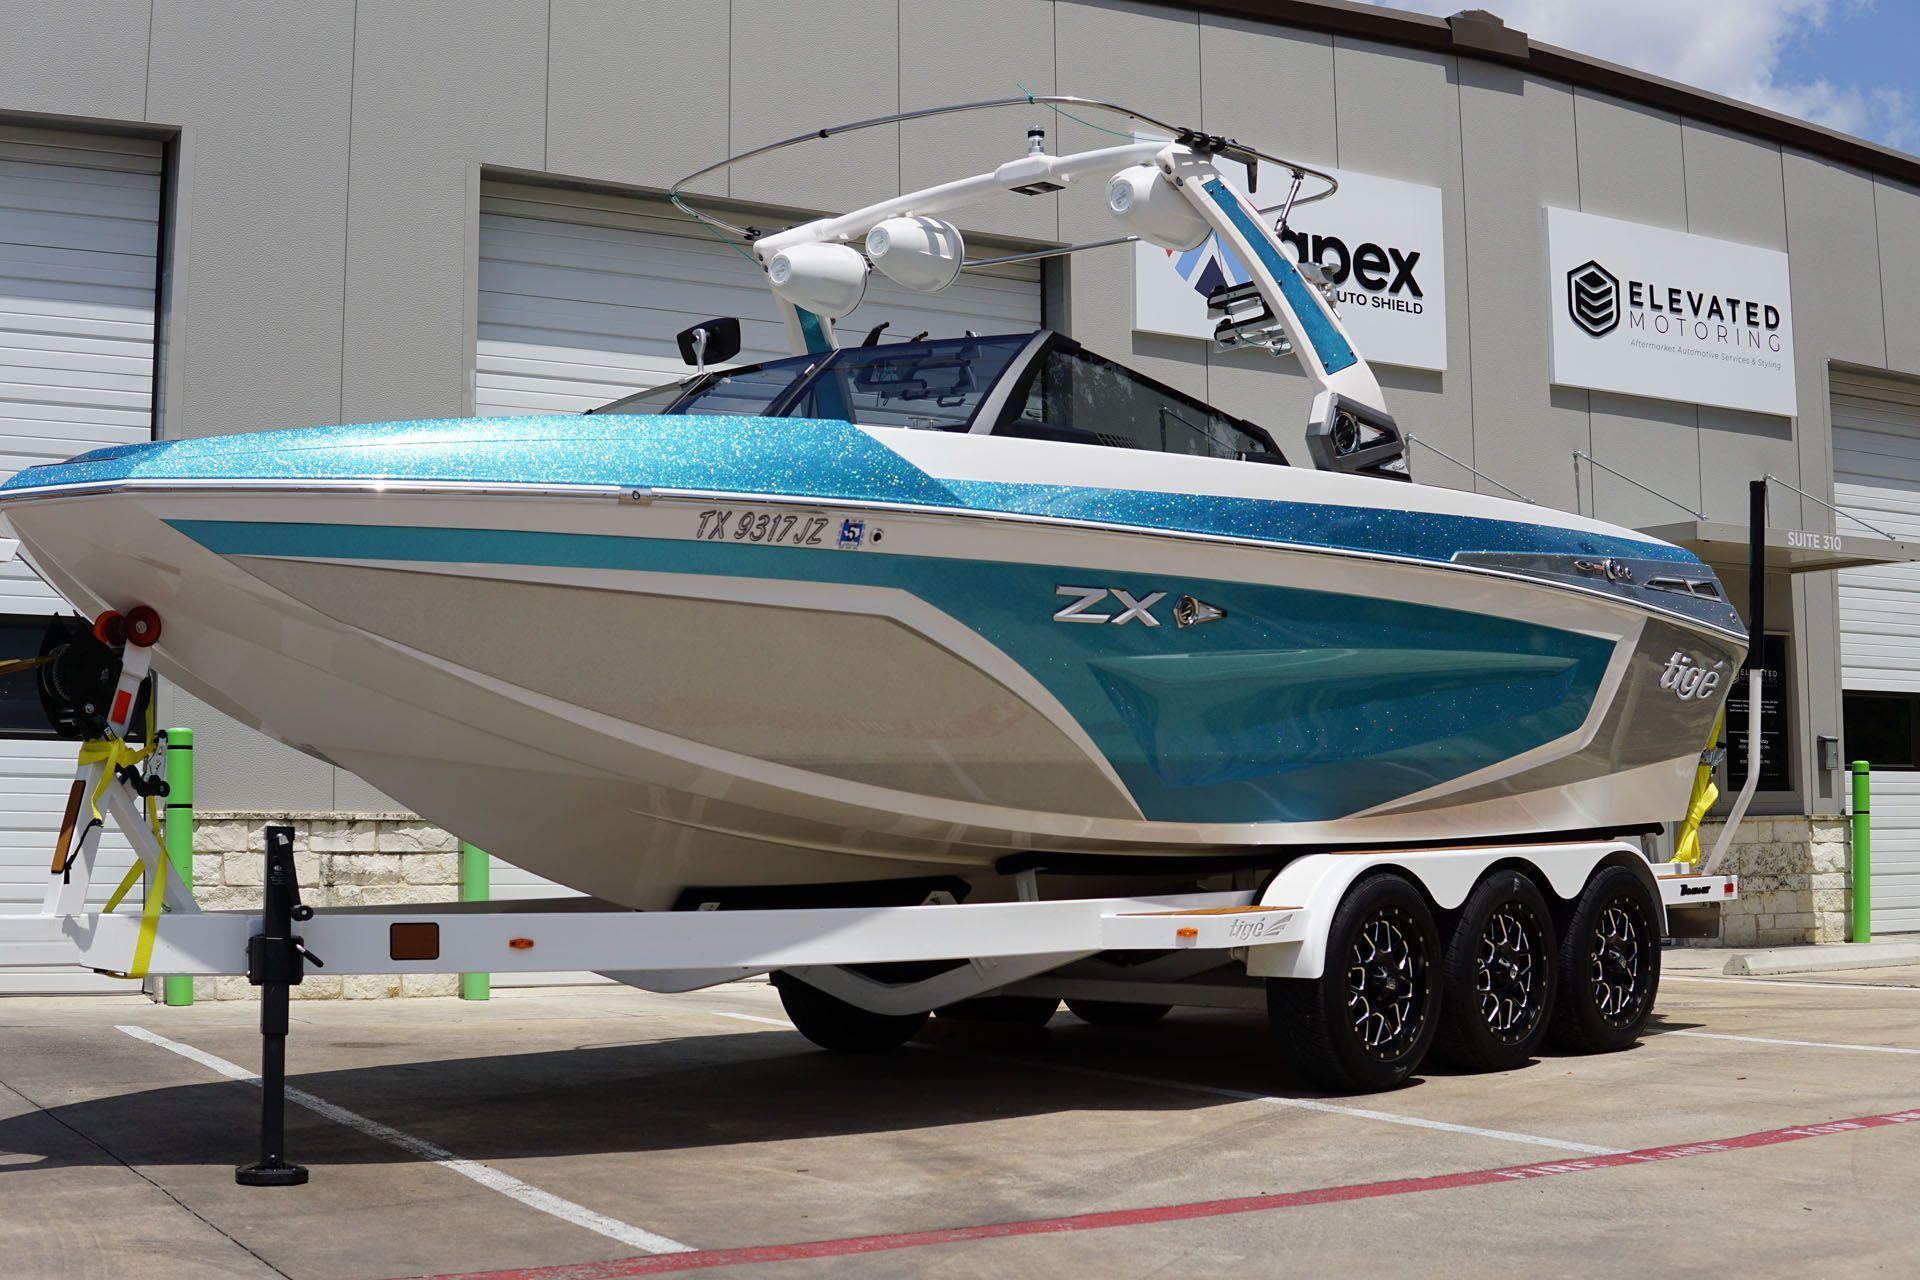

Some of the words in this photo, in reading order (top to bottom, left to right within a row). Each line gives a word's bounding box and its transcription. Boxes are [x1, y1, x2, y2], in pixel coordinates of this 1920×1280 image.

[1336, 291, 1367, 305] UTO
[1371, 296, 1423, 315] SHIELD
[1628, 280, 1780, 329] ELEVATED
[1629, 310, 1780, 352] MOTORING
[1630, 339, 1675, 353] Aftermarket
[1677, 346, 1719, 360] Automotive
[1721, 353, 1750, 365] Services
[1757, 358, 1781, 371] Styling
[696, 510, 732, 540] TX
[1788, 531, 1820, 549] SUITE
[1823, 535, 1842, 550] 310
[1053, 585, 1168, 627] ZX
[1660, 651, 1723, 700] tigé
[1741, 668, 1778, 678] ELTED
[1229, 917, 1265, 940] tigé
[1495, 1160, 1608, 1179] FIRE
